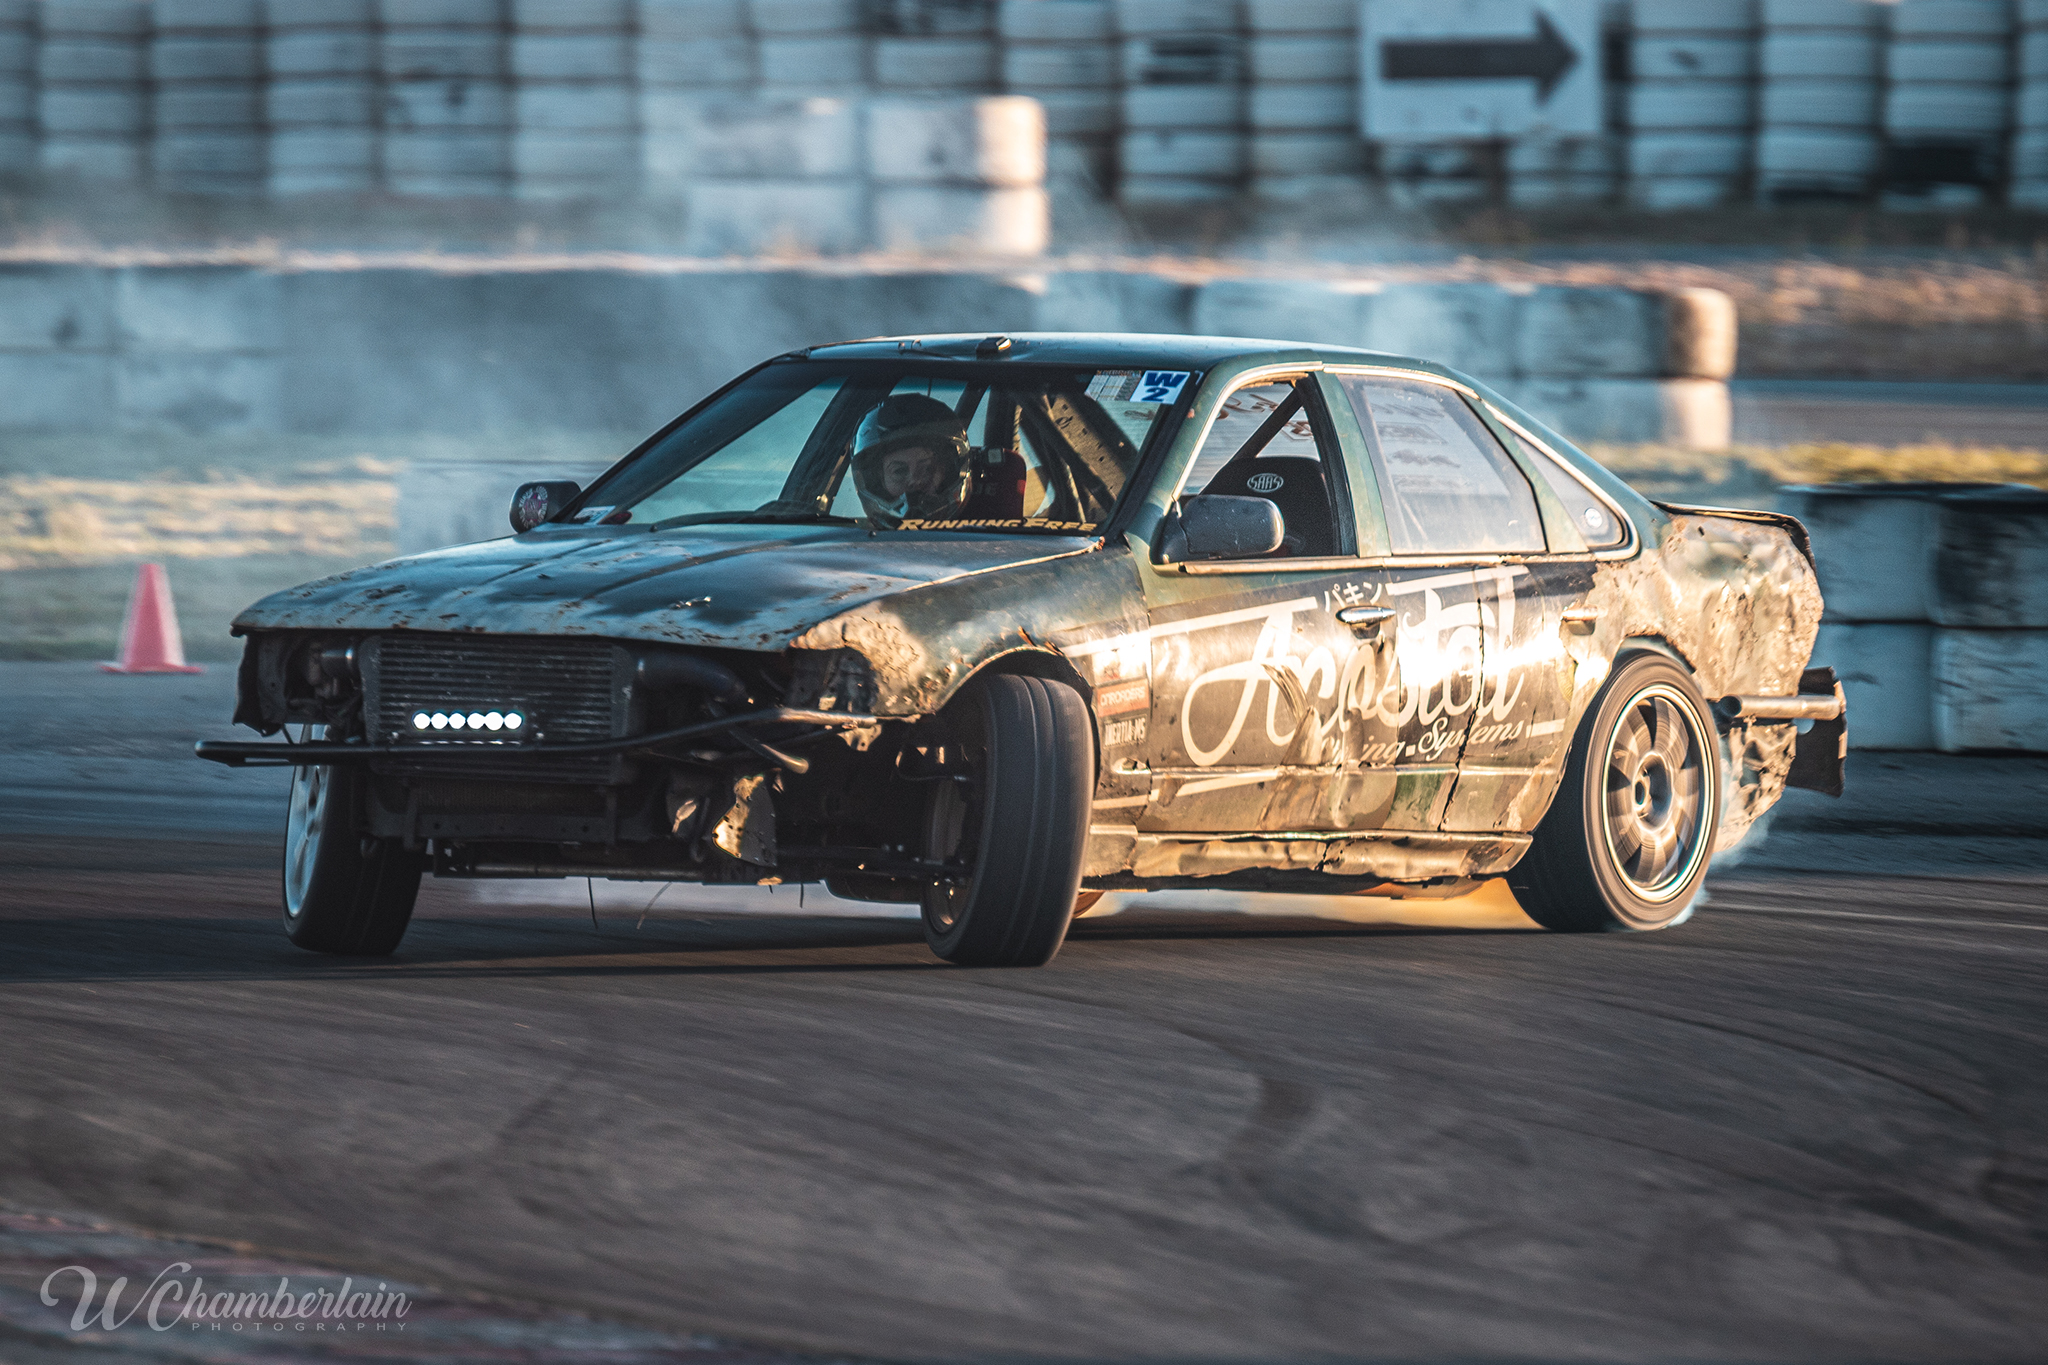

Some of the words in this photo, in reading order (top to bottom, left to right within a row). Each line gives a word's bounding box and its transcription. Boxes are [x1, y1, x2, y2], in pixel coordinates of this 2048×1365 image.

[1144, 372, 1187, 387] W
[1141, 386, 1169, 402] 2
[1249, 473, 1282, 491] SAAS
[898, 518, 1021, 531] RUNNING
